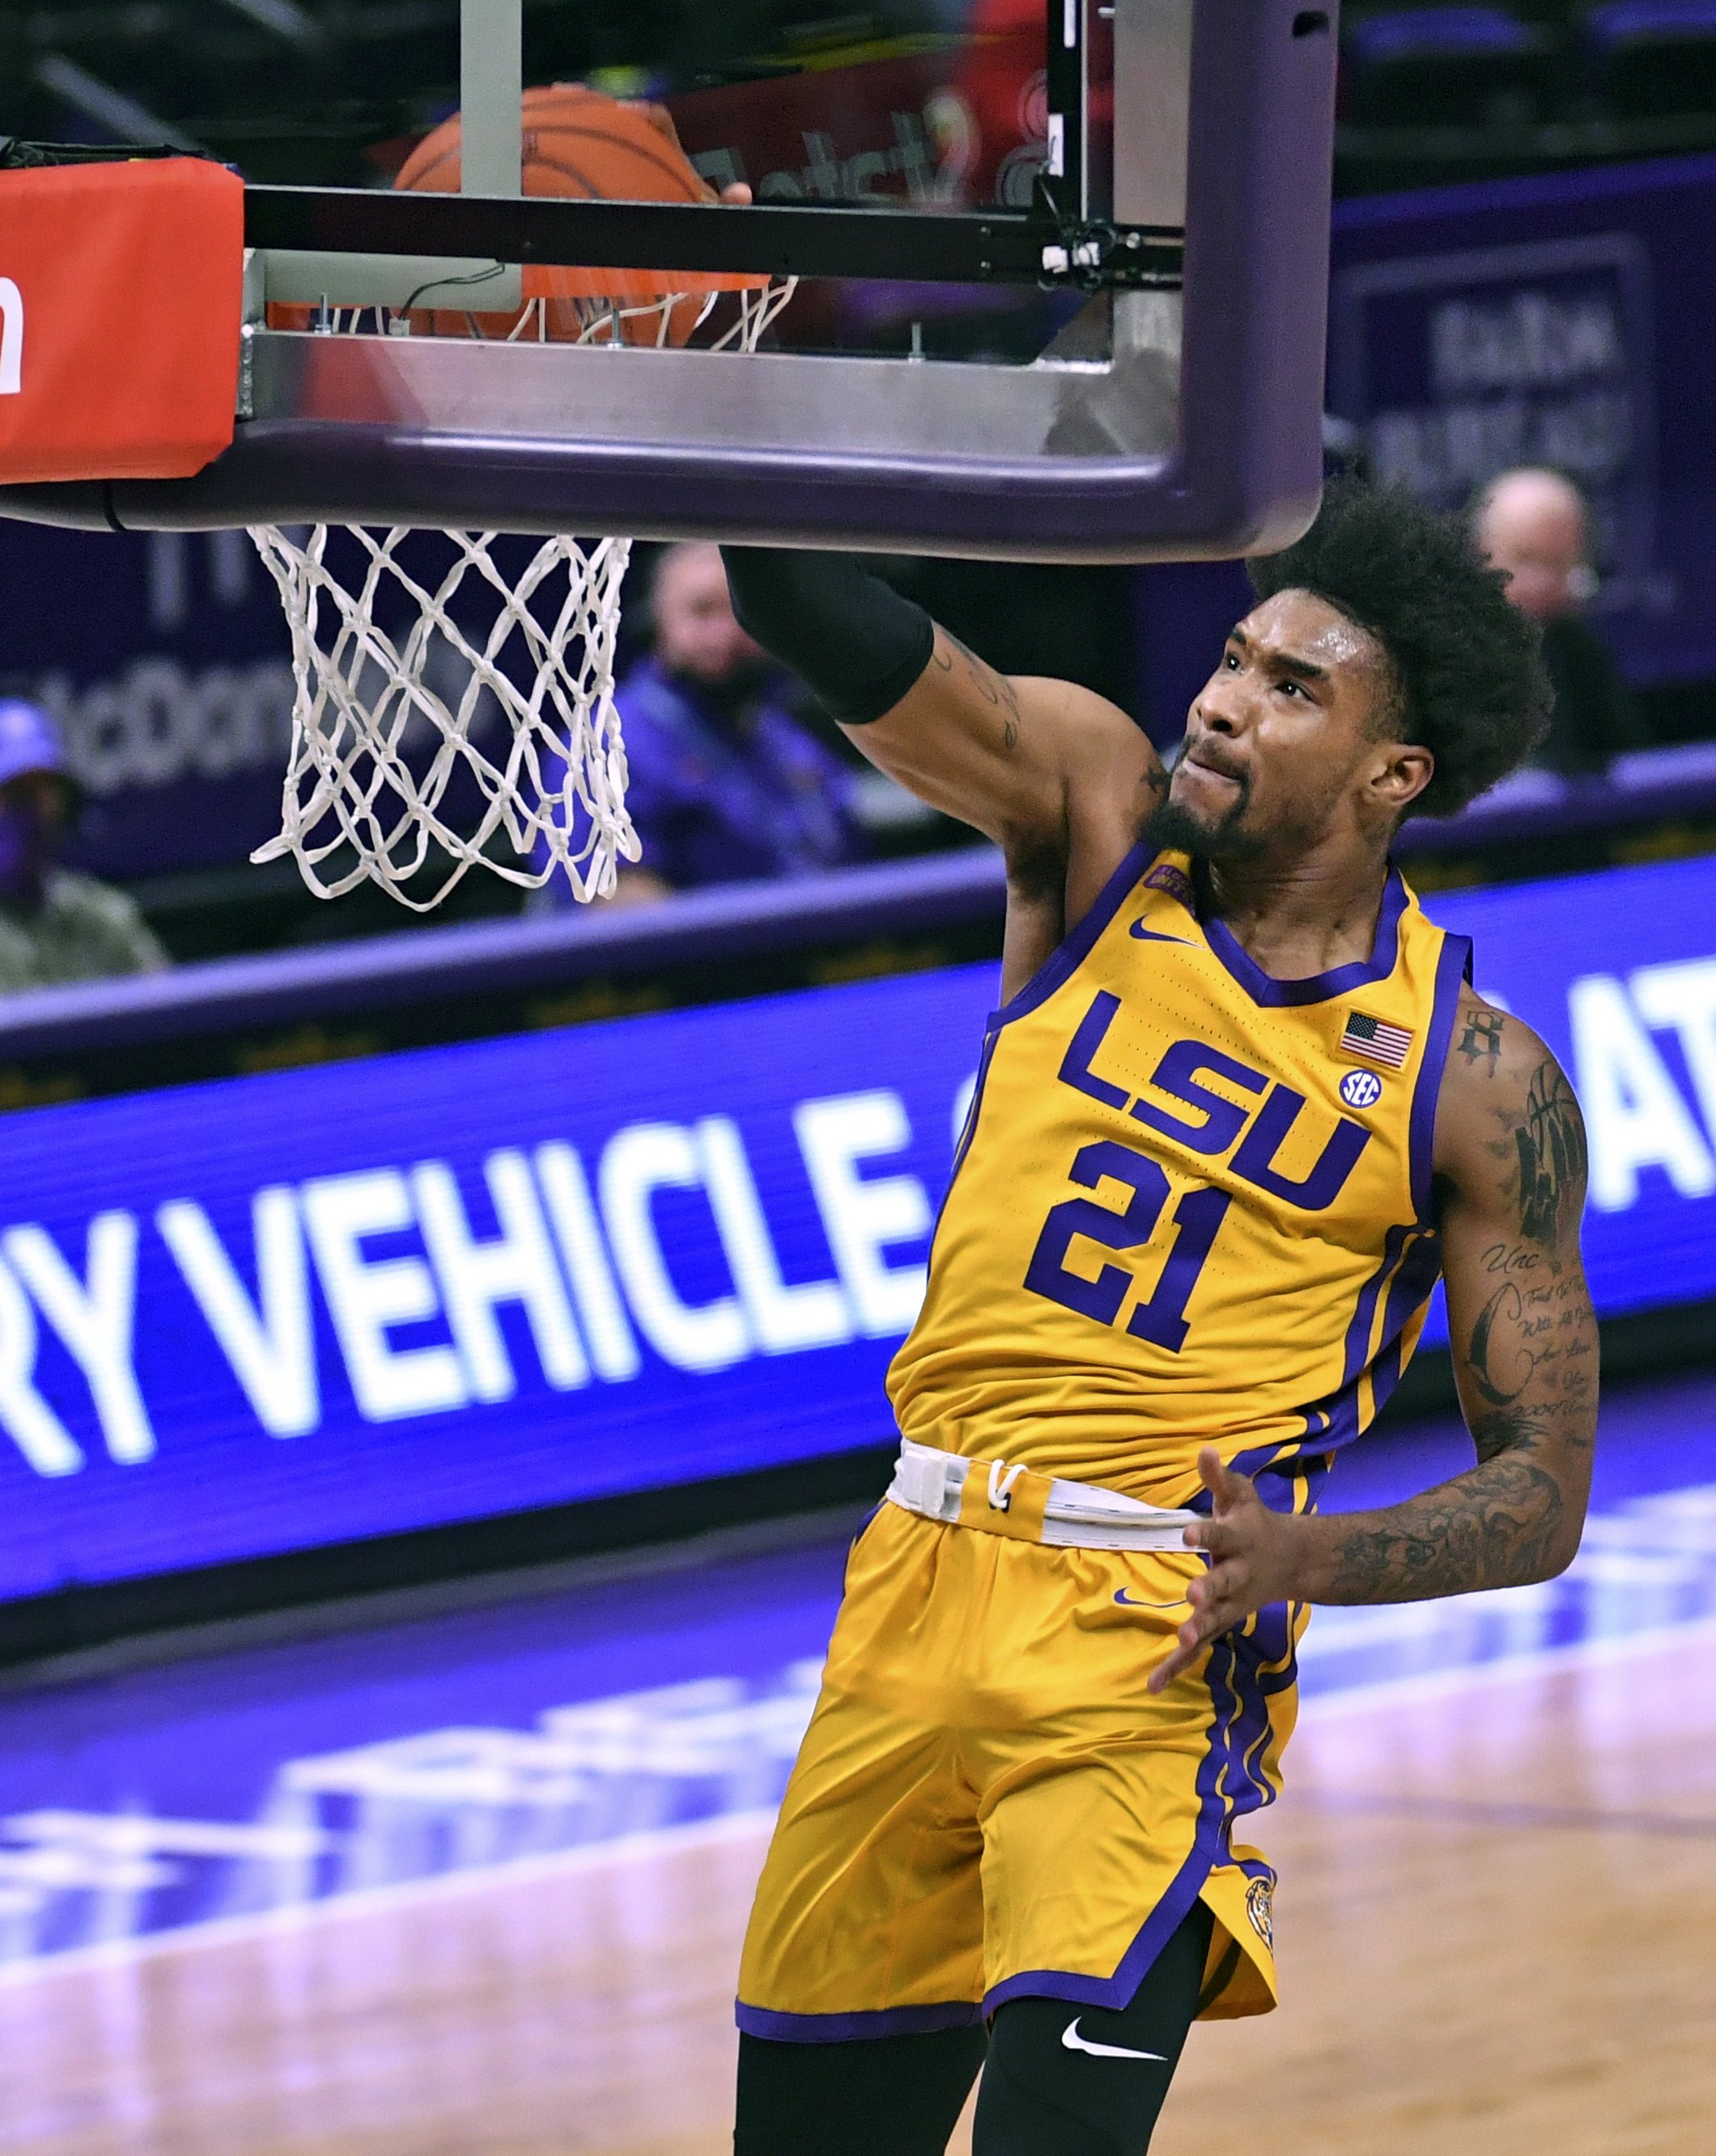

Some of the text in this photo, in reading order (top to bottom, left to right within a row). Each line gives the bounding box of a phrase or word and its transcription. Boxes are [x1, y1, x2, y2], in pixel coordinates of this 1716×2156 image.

[1057, 989, 1372, 1211] LSU
[1343, 1072, 1379, 1106] SEC
[155, 1086, 932, 1439] VEHICLE
[1022, 1140, 1234, 1354] 21
